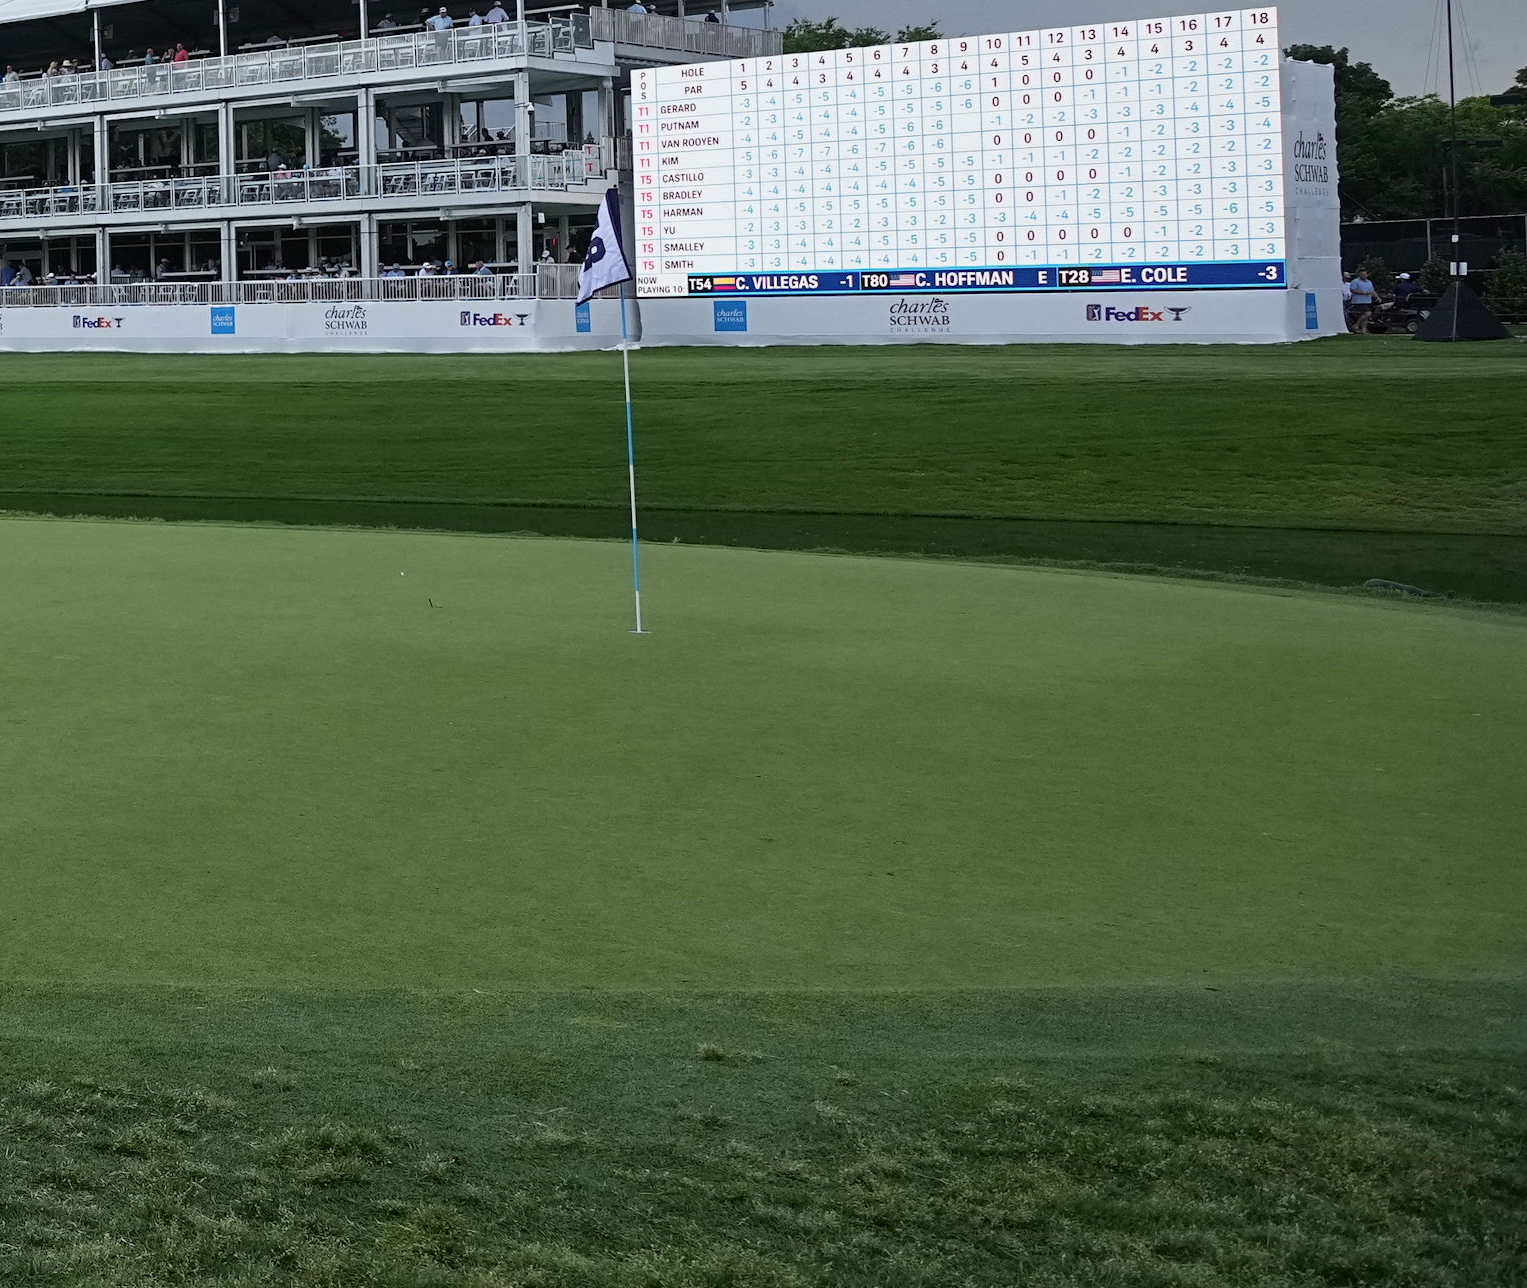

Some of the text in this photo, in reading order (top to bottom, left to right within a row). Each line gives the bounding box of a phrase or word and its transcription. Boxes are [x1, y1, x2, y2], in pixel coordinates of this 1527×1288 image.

[681, 12, 1269, 78] HOLE 1 2 3 4 5 6 7 8 9 10 11 12 13 14 15 16 17 18
[684, 33, 1265, 95] PAR 5 4 4 3 4 4 4 3 4 4 5 4 3 4 4 3 4 4
[638, 54, 1269, 117] T1 GERARD -3 -4 -5 -5 -4 -5 -5 -6 -6 1 0 0 0 -1 -2 -2 -2 -2
[638, 75, 1269, 134] T1 PUTNAM -2 -3 -4 -4 -4 -5 -5 -5 -6 0 0 0 -1 -1 -1 -2 -2 -2
[639, 136, 719, 151] T1 VAN ROOYEN
[1294, 131, 1327, 160] charles
[639, 134, 1001, 168] T1 KIM 0
[640, 172, 705, 185] T5 CASTILLO
[1295, 164, 1329, 182] SCHWAB
[640, 190, 703, 202] T5 BRADLEY
[641, 207, 703, 219] T5 HARMAN
[641, 226, 676, 236] T5 YU
[642, 242, 704, 253] T5 SMALLEY
[643, 260, 694, 270] T5 SMITH
[638, 277, 657, 285] NOW
[862, 271, 1047, 287] T80 C. HOFFMAN E
[1059, 266, 1277, 284] T28 E. COLE -3
[638, 285, 685, 294] PLAYING 10:
[689, 275, 853, 291] T54 C. VILLEGAS -1
[325, 305, 366, 319] charles
[890, 297, 949, 314] charles
[473, 313, 512, 326] FedEx
[716, 309, 743, 317] charles
[1105, 306, 1164, 321] FedEx
[82, 318, 112, 328] FedEx
[325, 321, 367, 329] SCHWAB
[890, 316, 950, 326] SCHWAB
